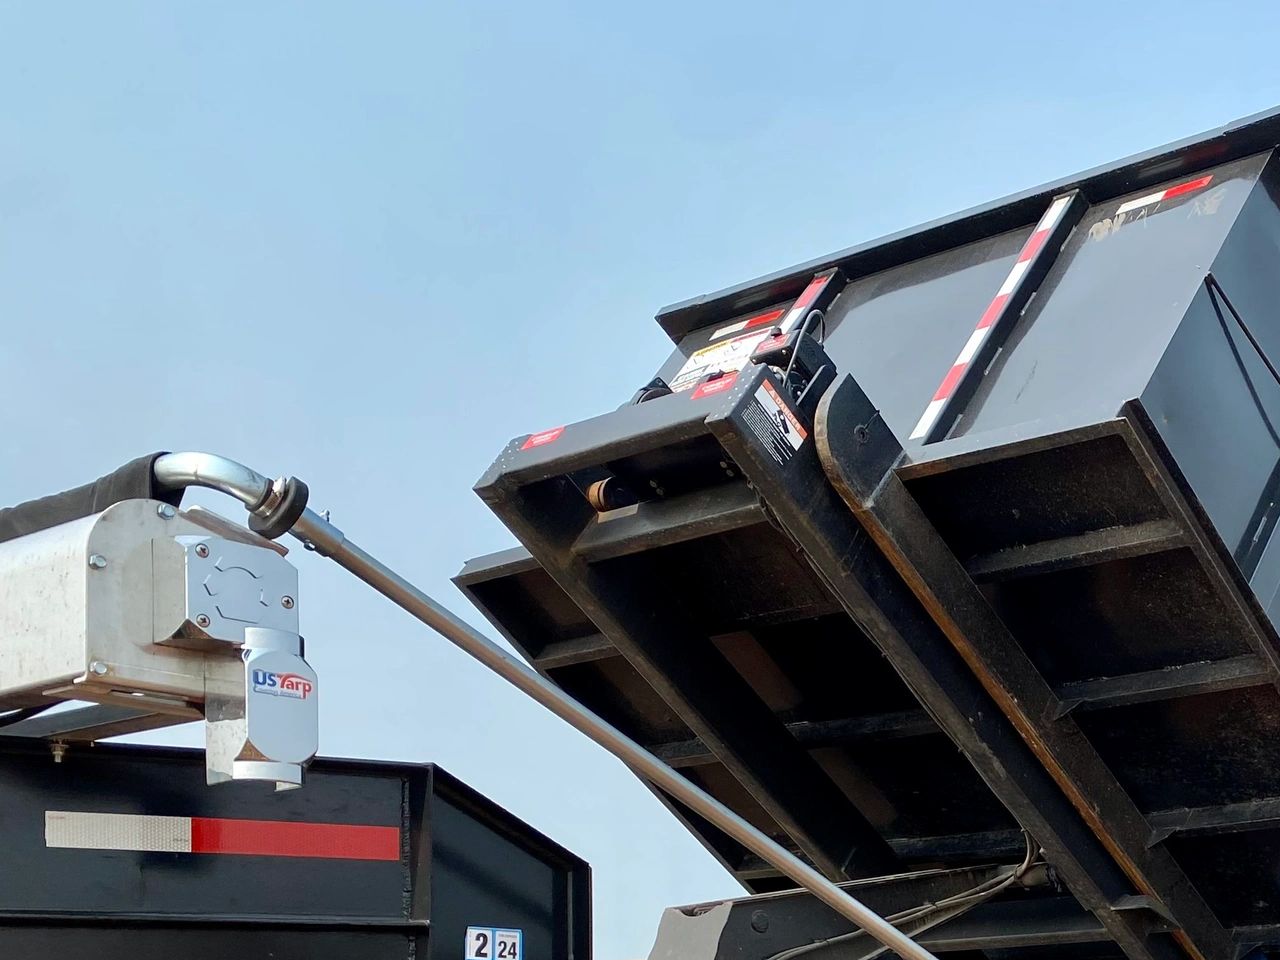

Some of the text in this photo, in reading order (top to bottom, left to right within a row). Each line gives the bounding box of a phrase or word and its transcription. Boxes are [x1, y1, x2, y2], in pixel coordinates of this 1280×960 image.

[775, 395, 801, 431] DANGER
[475, 932, 488, 958] 2
[498, 941, 517, 959] 24
